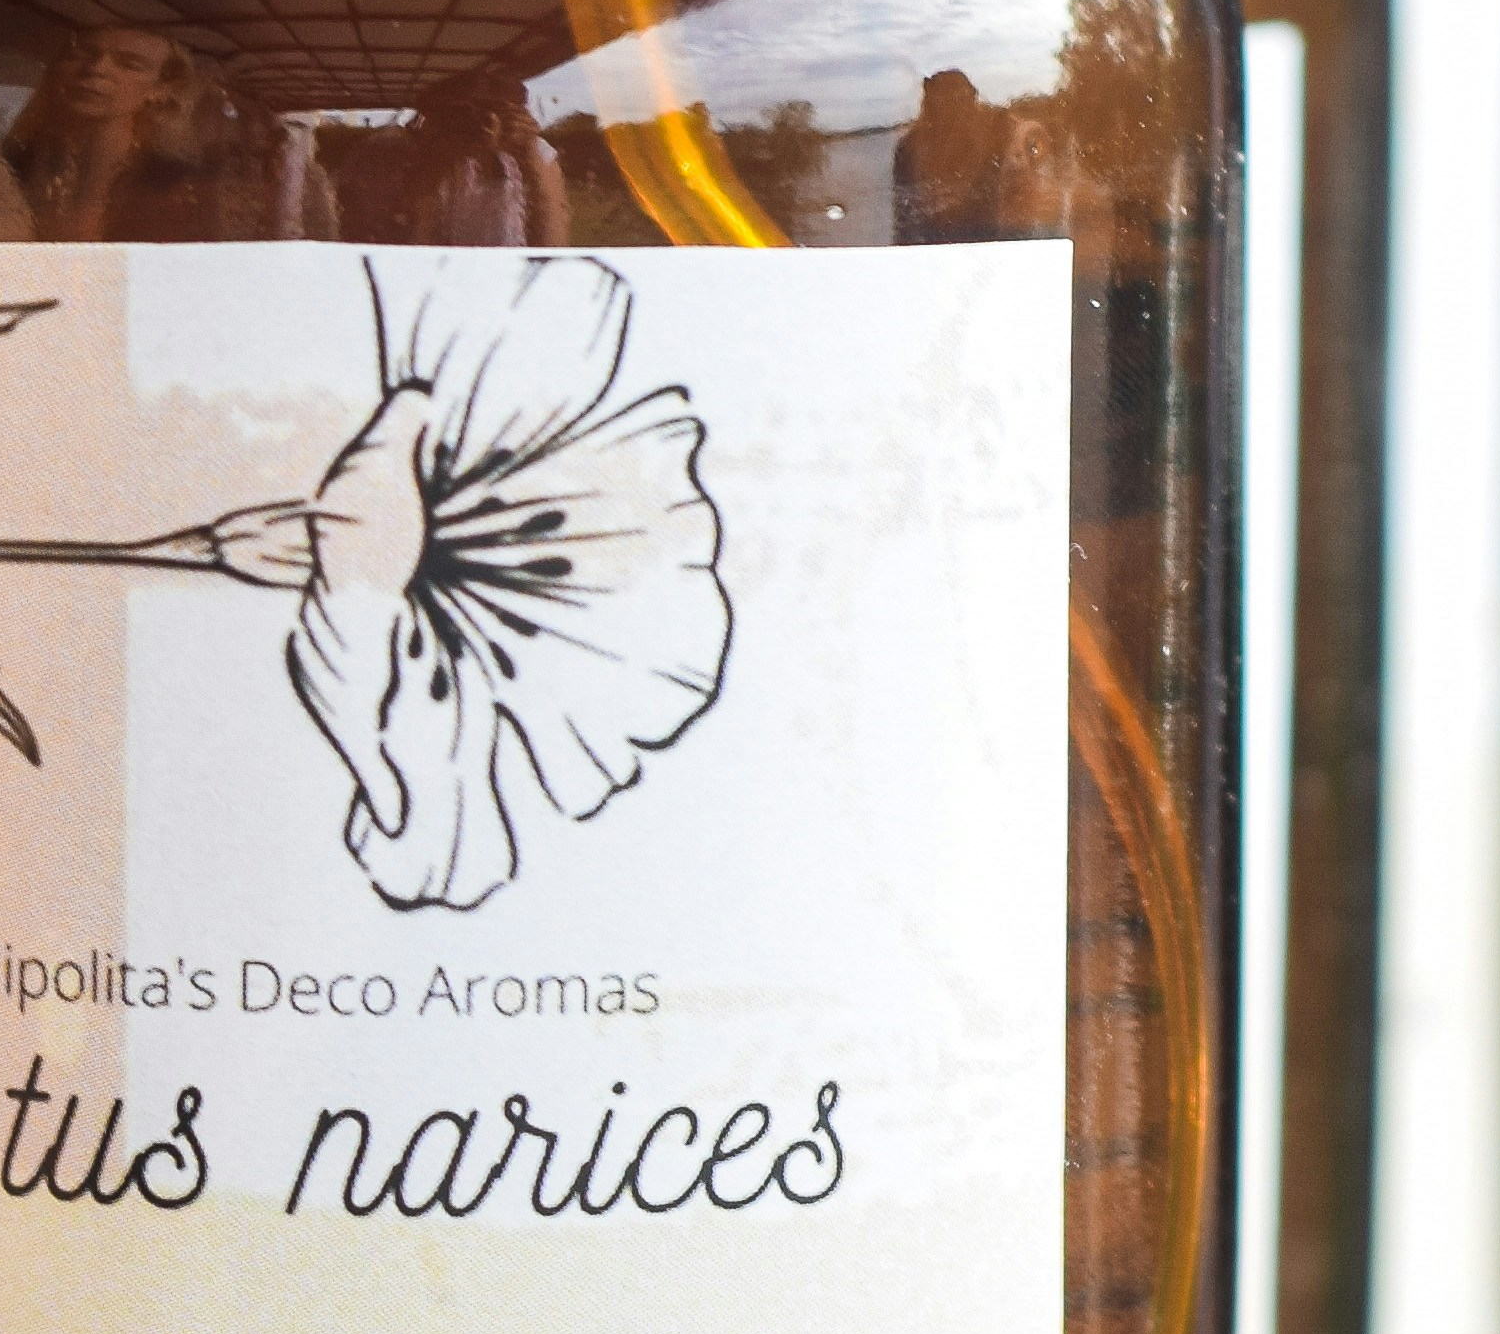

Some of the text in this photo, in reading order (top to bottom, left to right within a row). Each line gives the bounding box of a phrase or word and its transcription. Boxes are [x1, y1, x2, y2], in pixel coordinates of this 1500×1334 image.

[239, 958, 398, 1018] Deco
[416, 964, 662, 1019] Aromas
[0, 1053, 209, 1212] tus
[284, 1079, 845, 1219] narices
